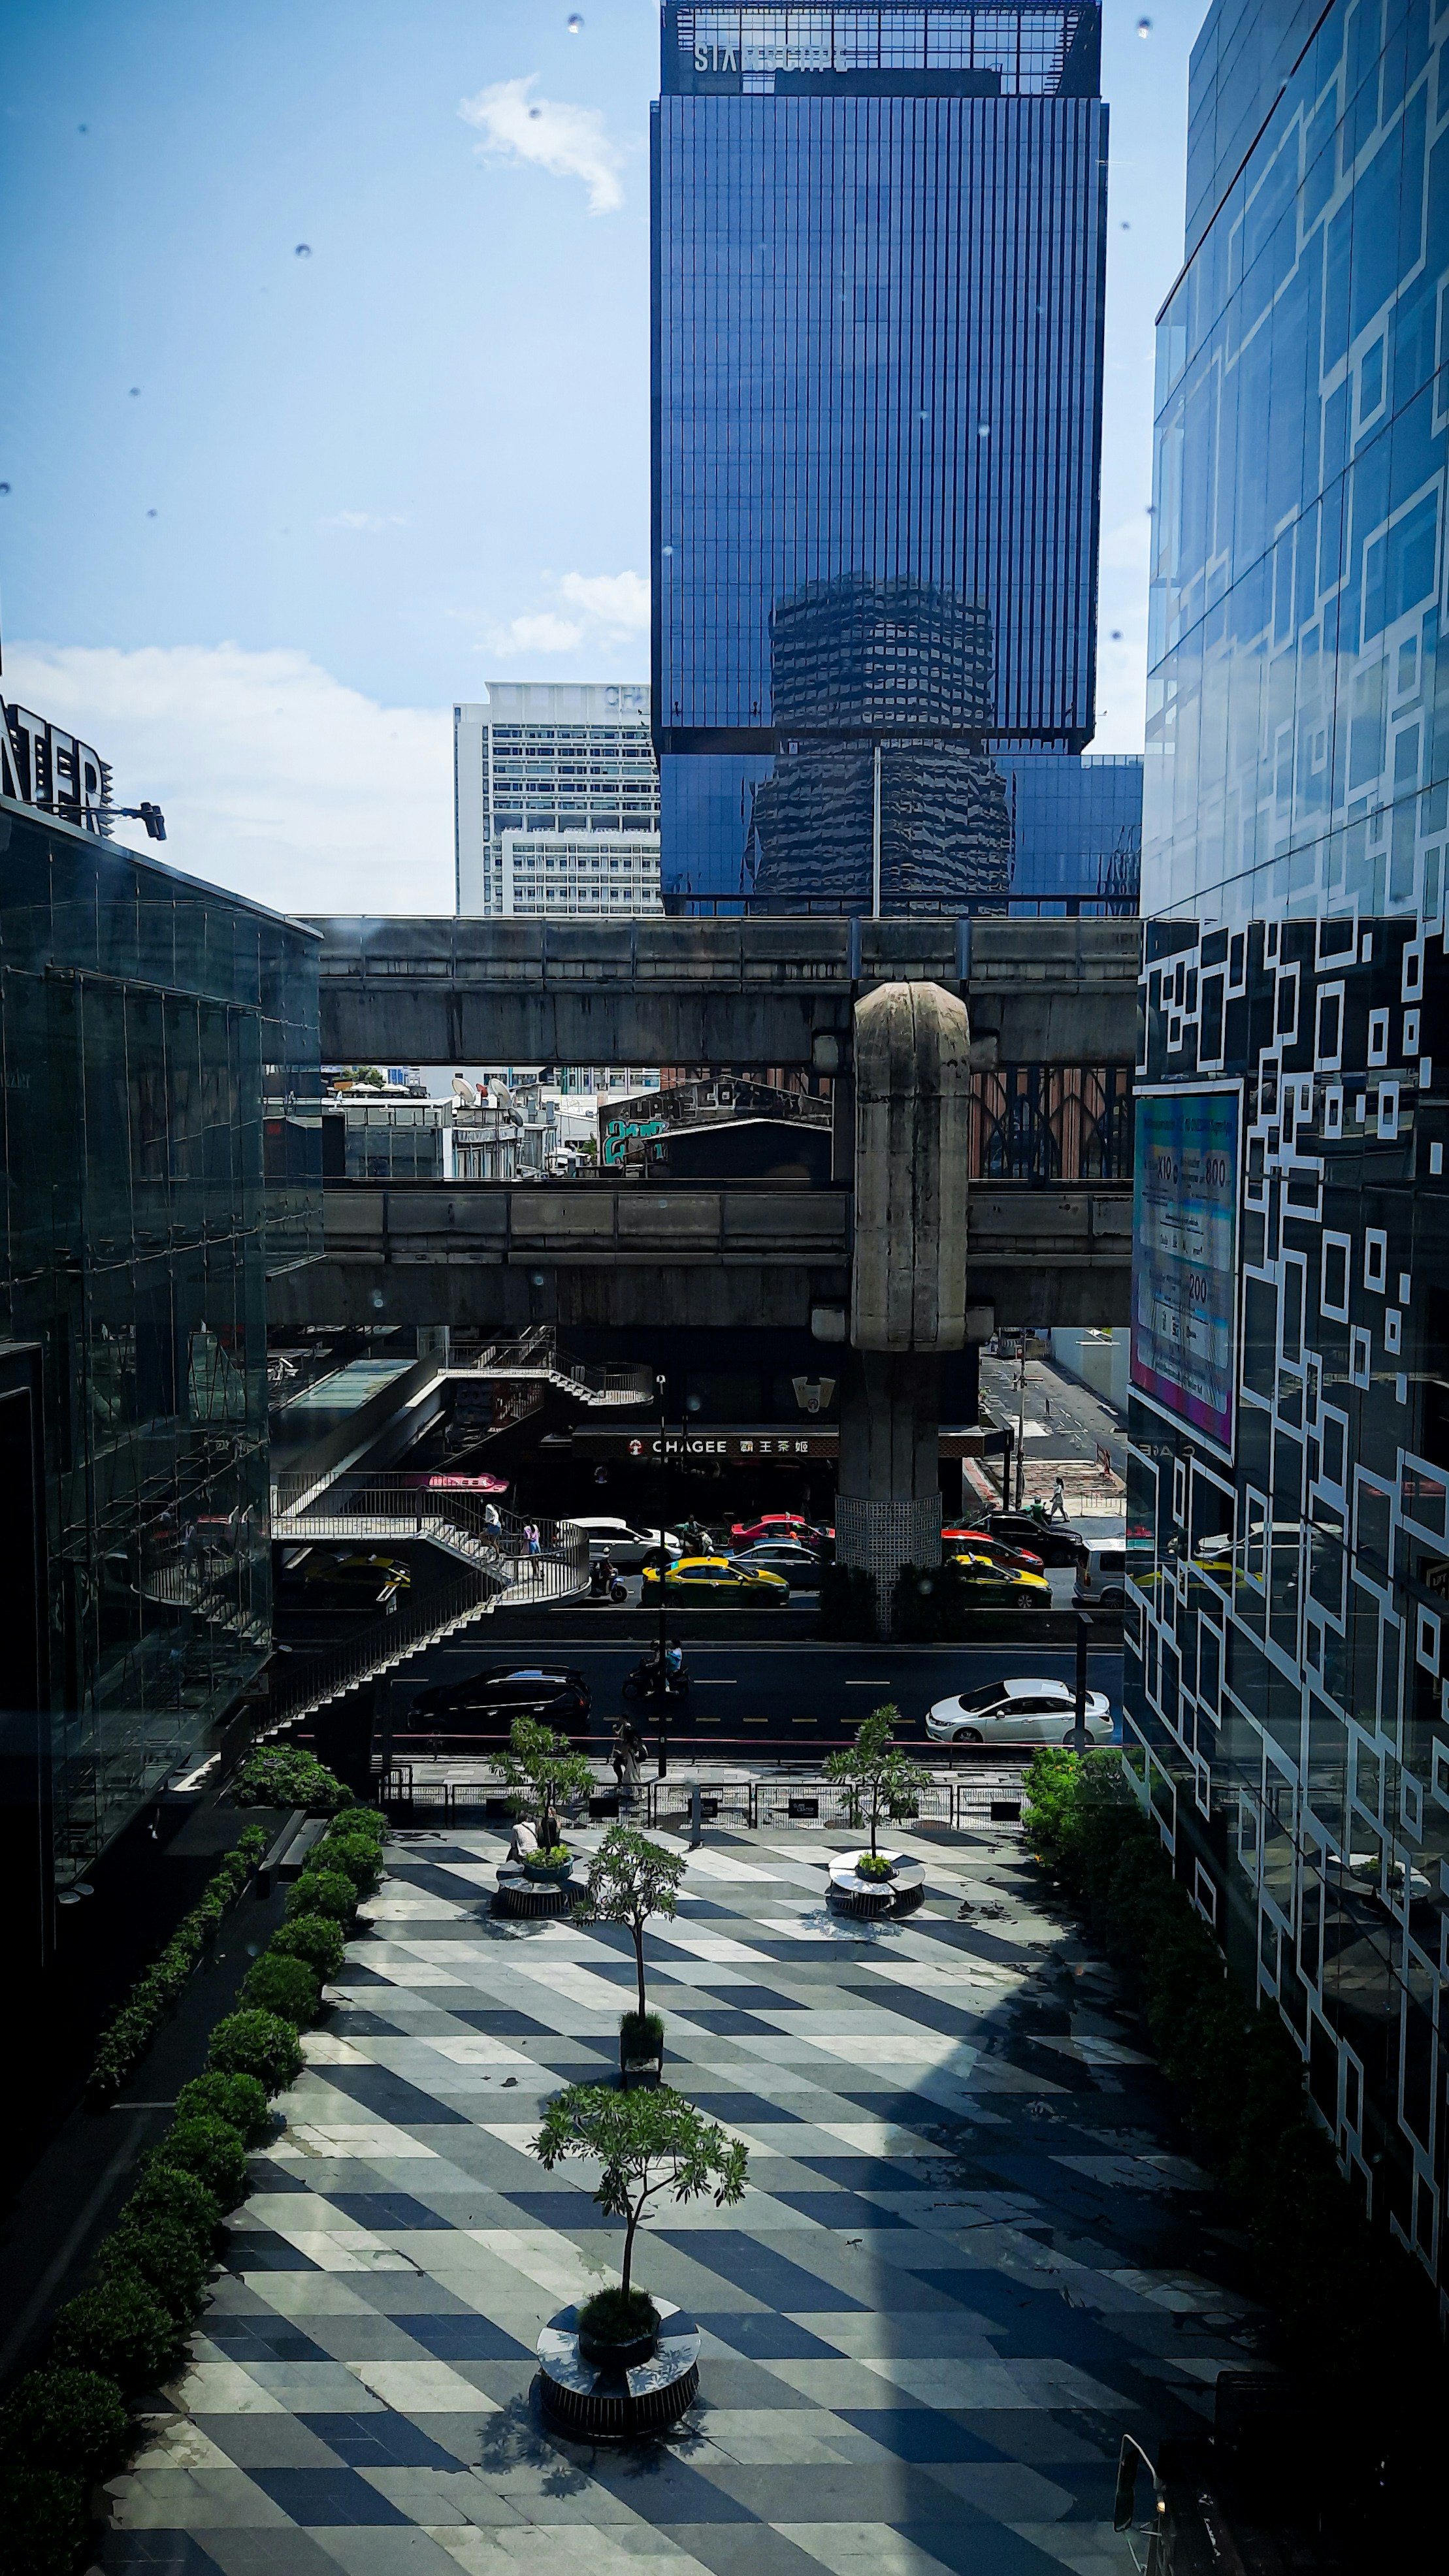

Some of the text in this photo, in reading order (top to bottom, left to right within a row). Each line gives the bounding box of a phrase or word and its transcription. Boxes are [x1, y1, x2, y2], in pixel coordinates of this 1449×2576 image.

[1206, 1158, 1225, 1187] 800
[1189, 1274, 1207, 1303] 200
[653, 1440, 727, 1453] CHAGEE
